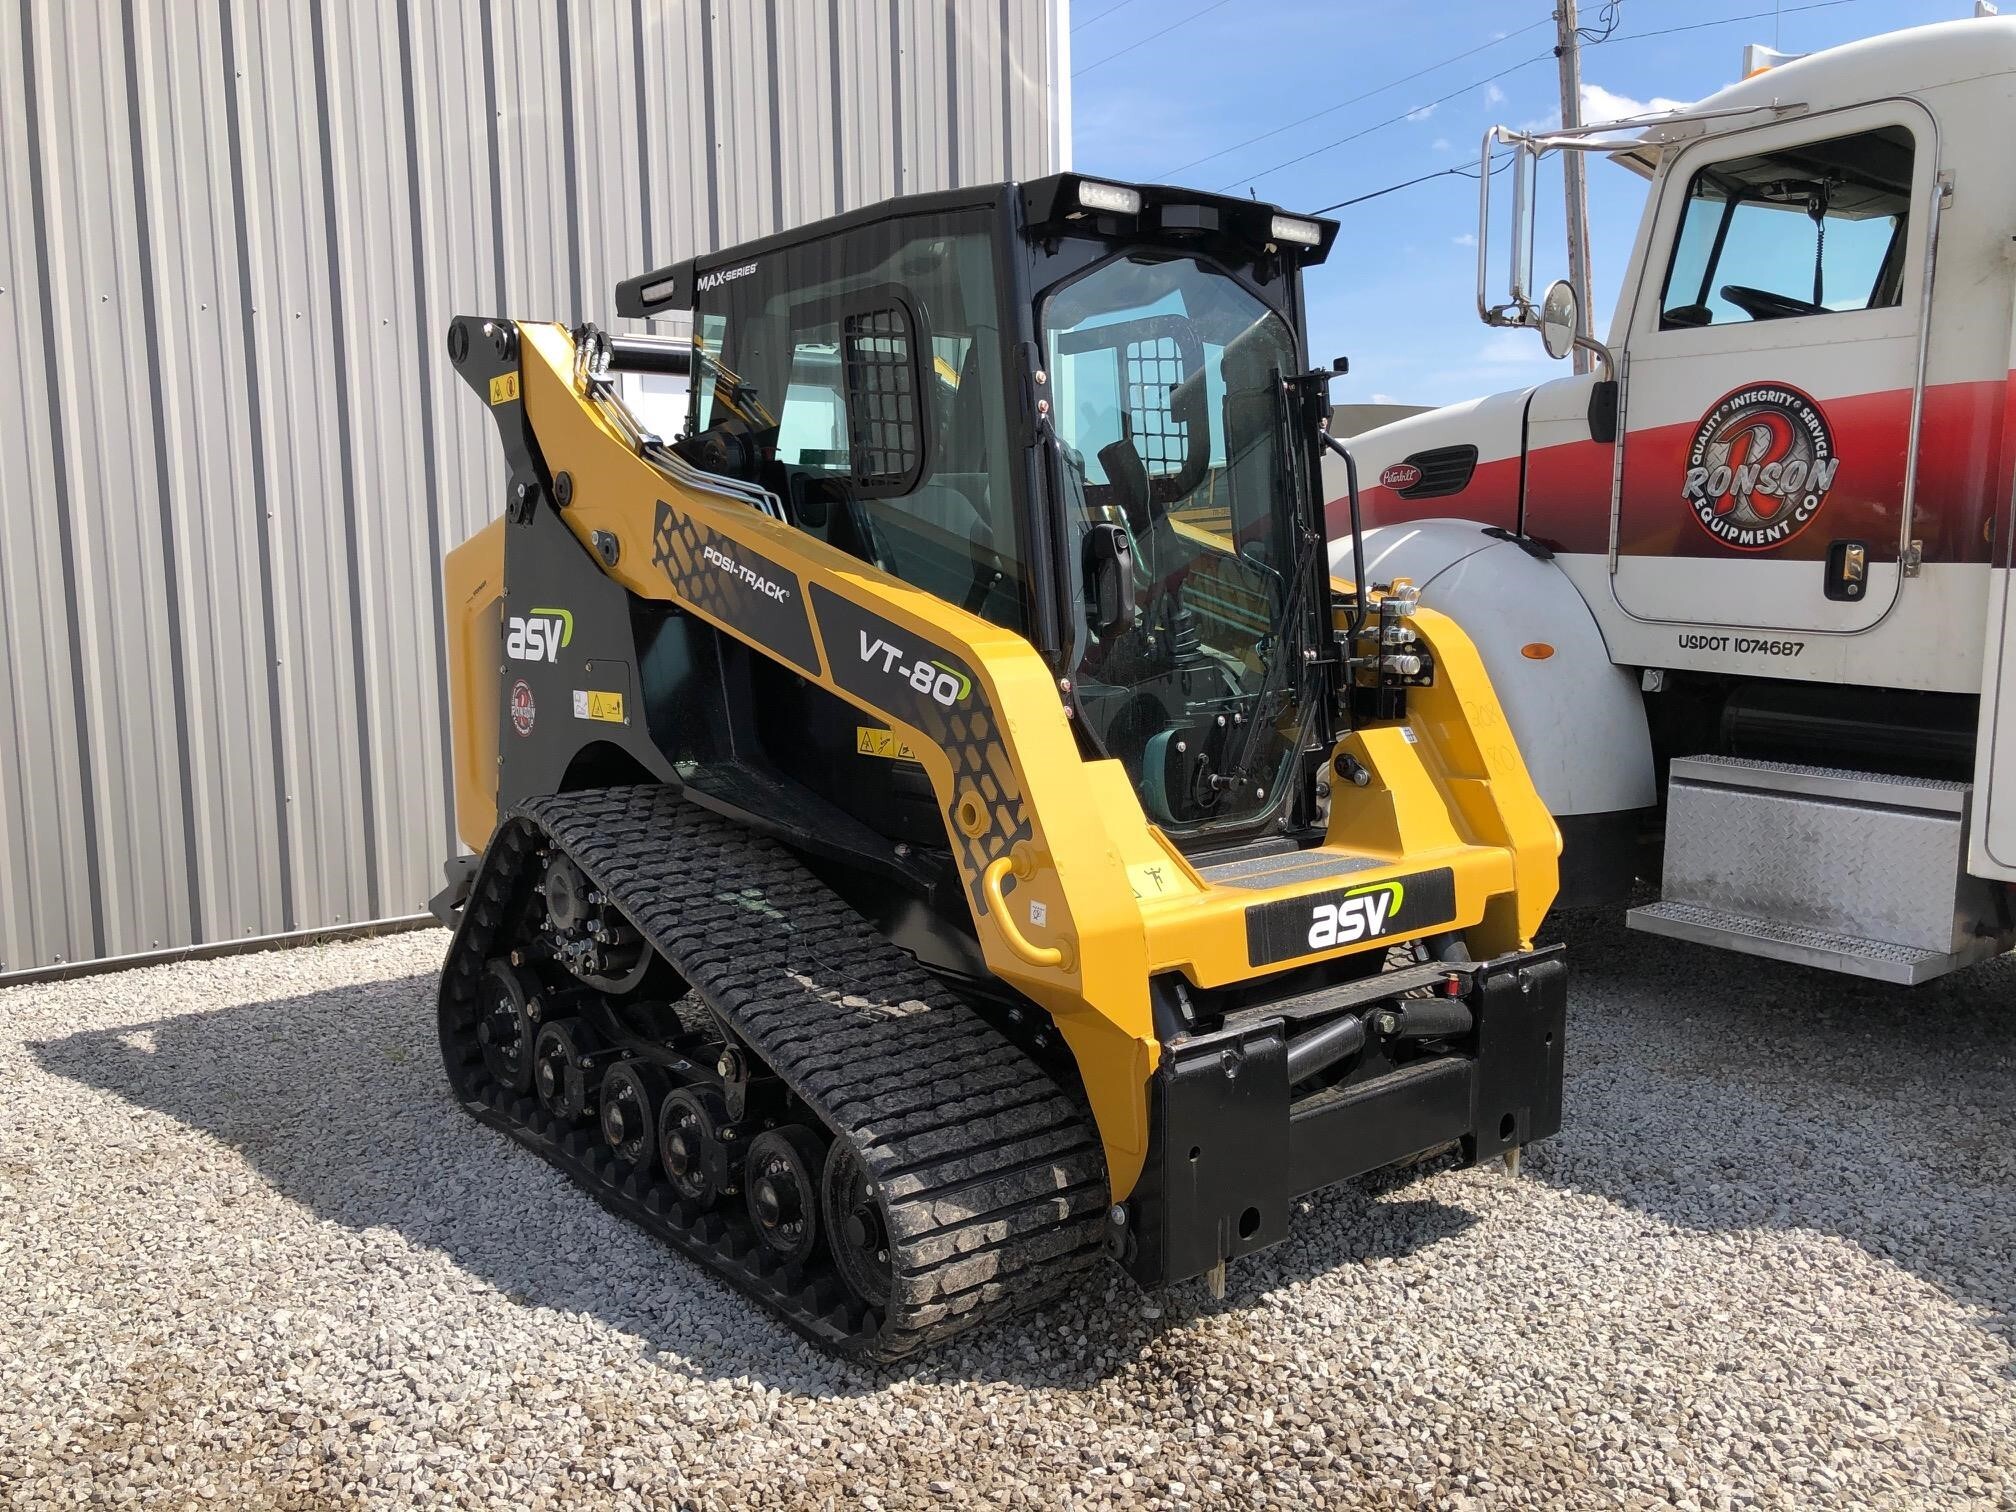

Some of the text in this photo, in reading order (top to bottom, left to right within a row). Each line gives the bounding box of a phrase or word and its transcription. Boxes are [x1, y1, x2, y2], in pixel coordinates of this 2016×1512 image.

[697, 263, 758, 291] MAX-SERIES
[1692, 390, 1828, 466] QUALITY INTEGRITY SERVICE
[1383, 469, 1417, 485] Peterbilt
[1681, 457, 1840, 499] RONSON
[1694, 489, 1824, 545] EQUIPMENT CO.
[703, 545, 787, 604] POSI-TRACK
[860, 629, 960, 707] VT-80
[1678, 634, 1805, 657] USDOT 1074687
